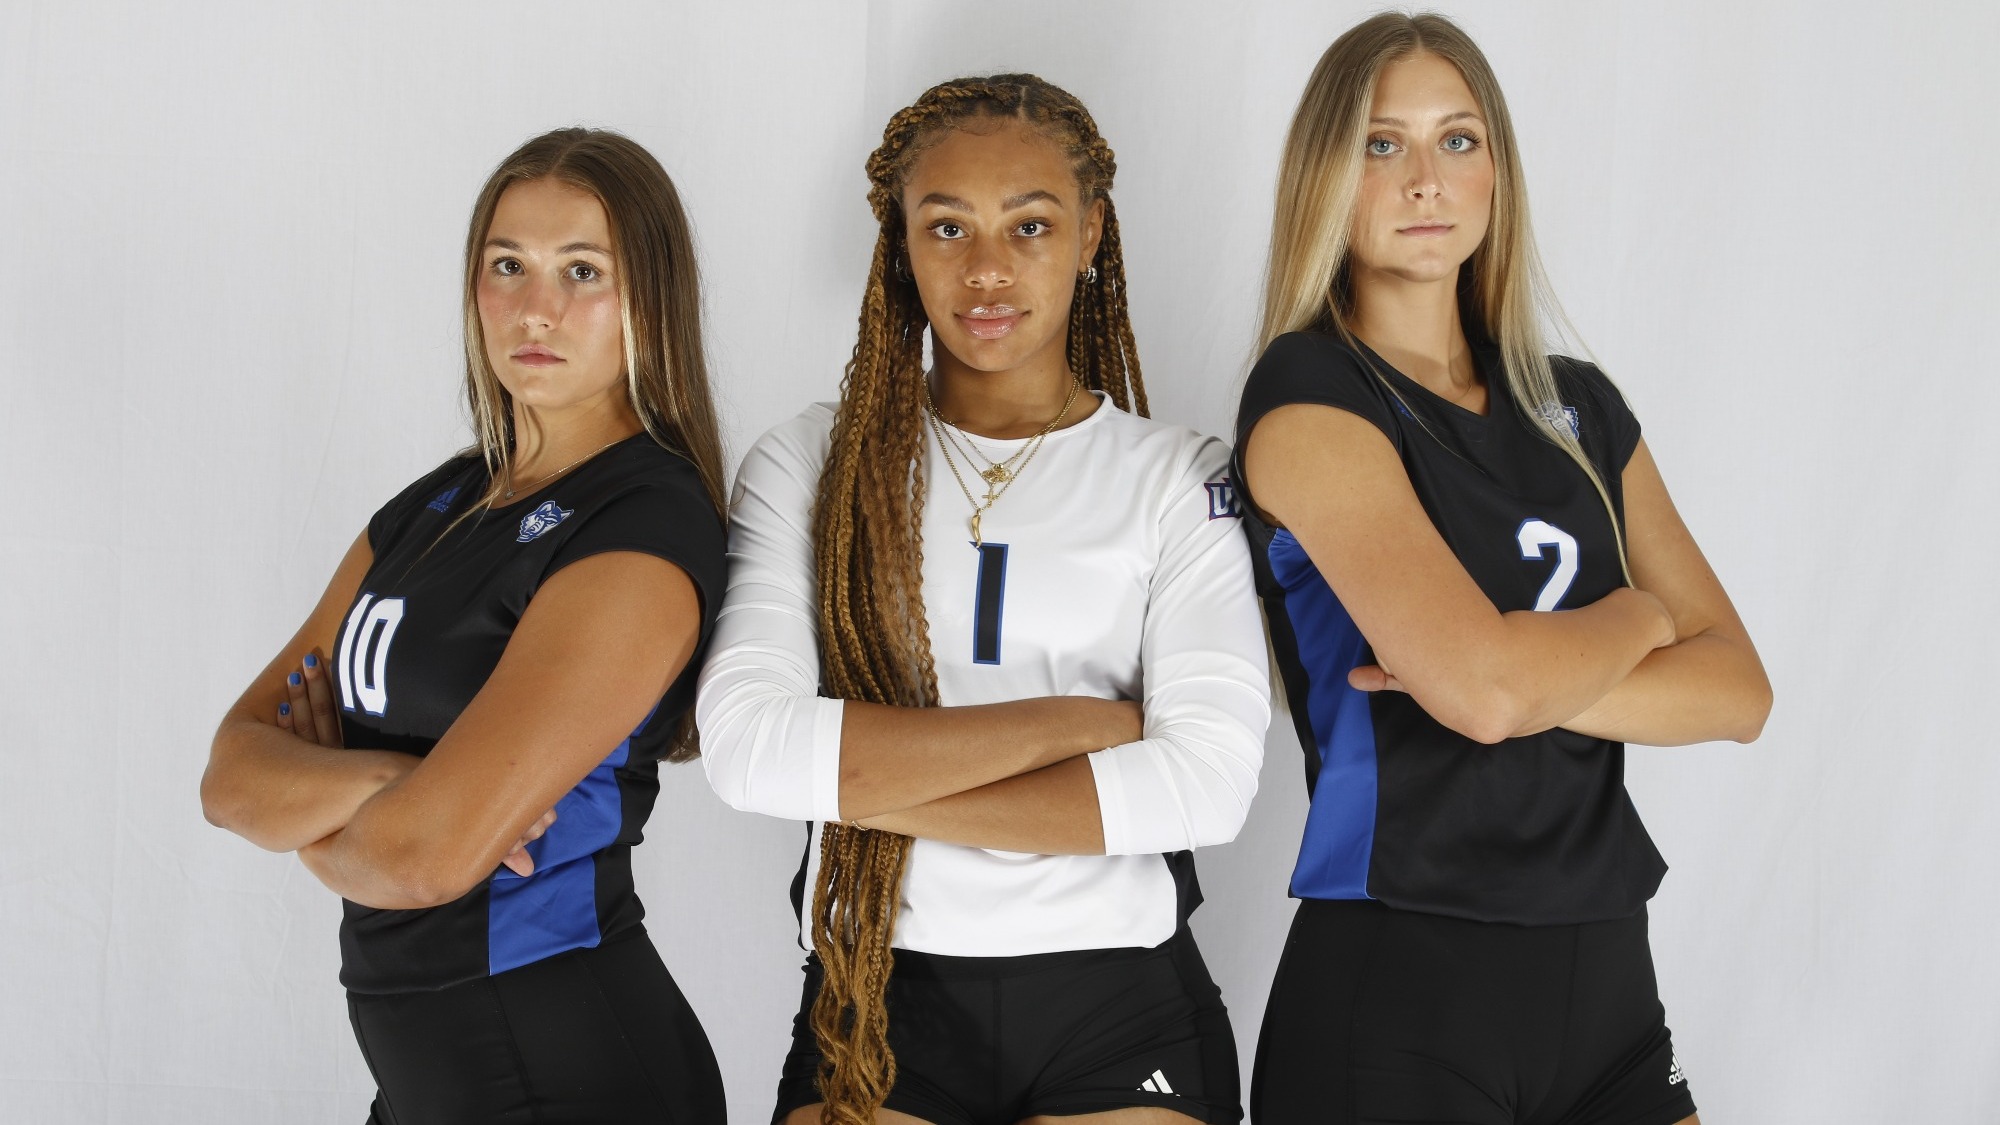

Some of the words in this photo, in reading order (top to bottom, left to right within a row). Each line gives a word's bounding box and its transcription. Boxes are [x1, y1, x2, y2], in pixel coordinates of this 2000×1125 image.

[968, 541, 1009, 666] 1
[1515, 518, 1580, 612] 2
[338, 592, 406, 717] 10
